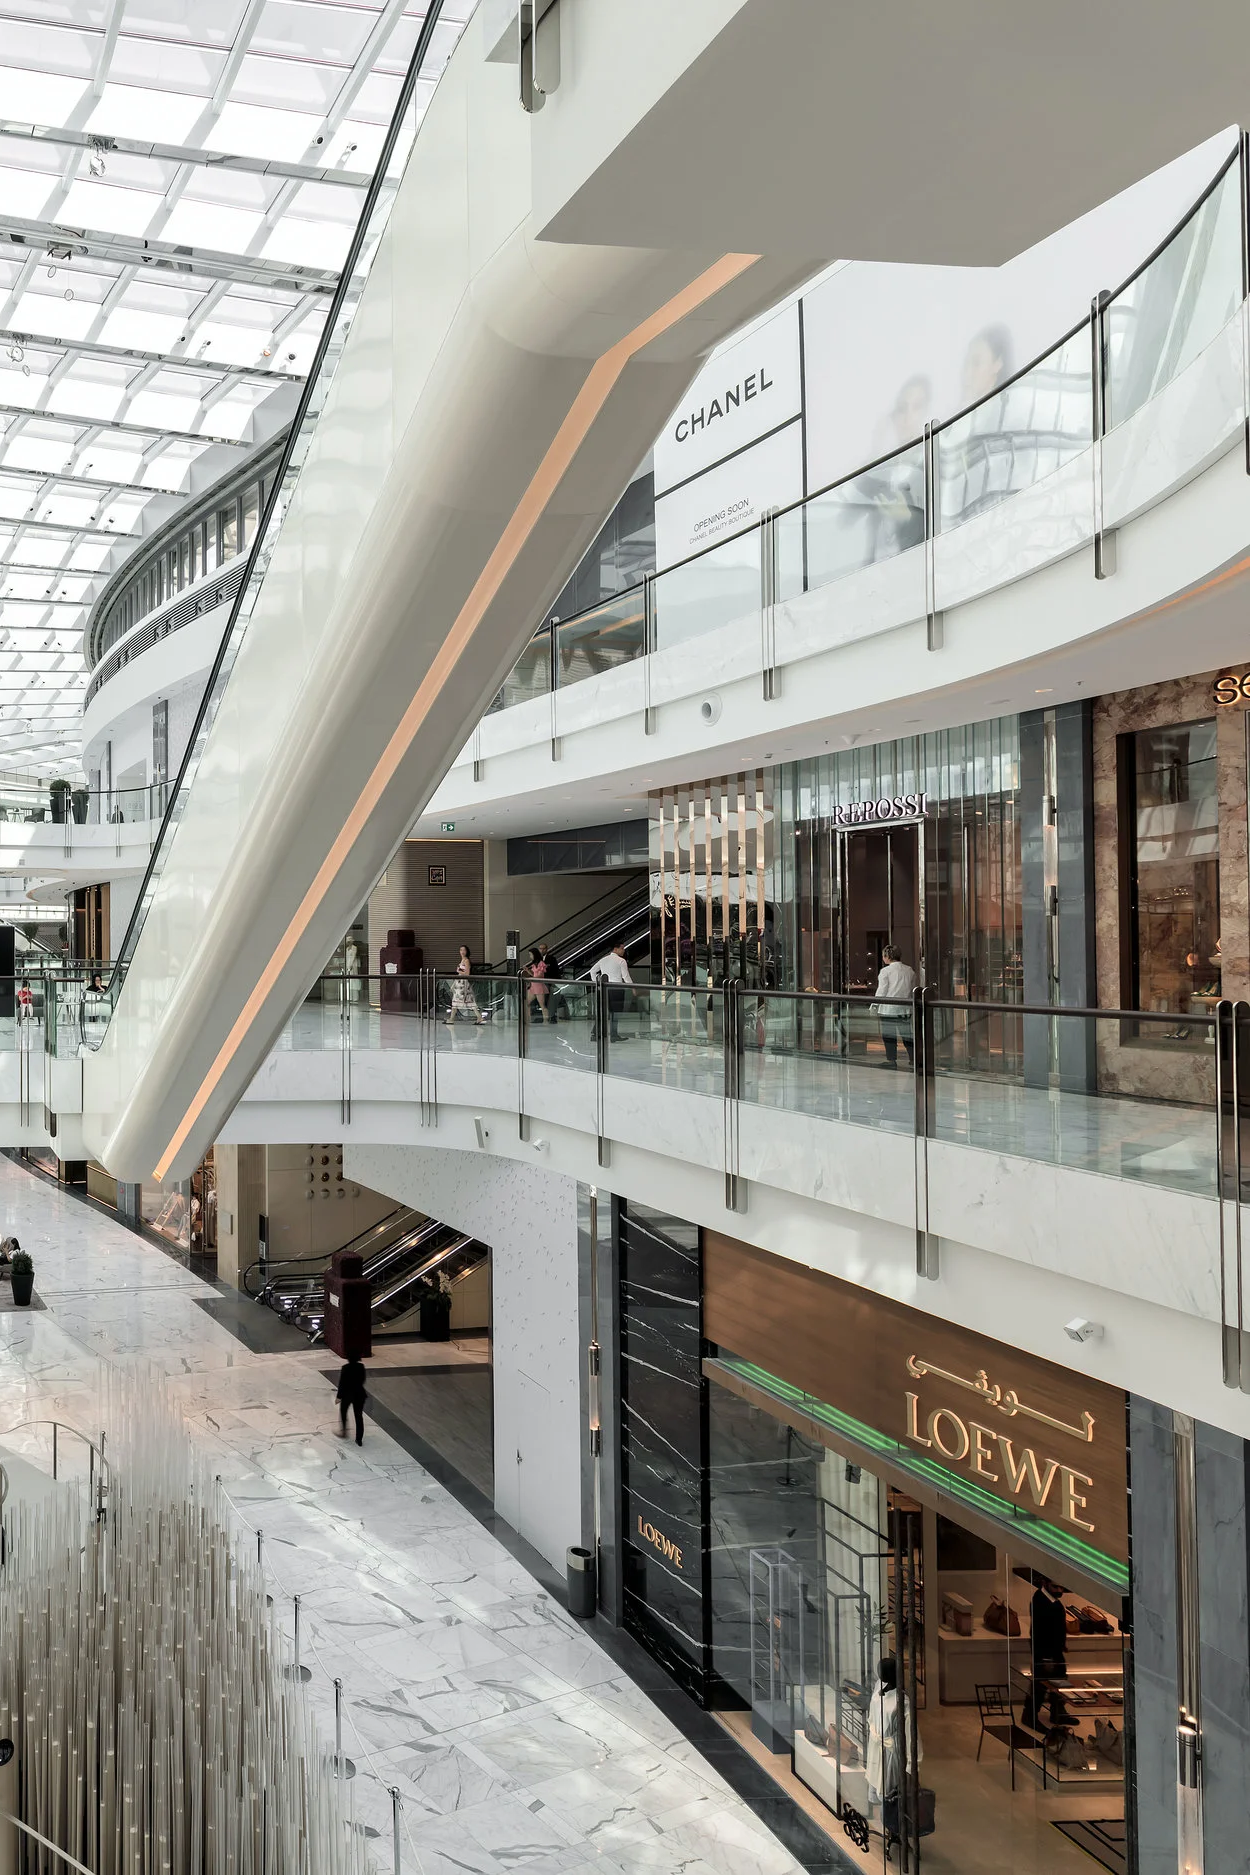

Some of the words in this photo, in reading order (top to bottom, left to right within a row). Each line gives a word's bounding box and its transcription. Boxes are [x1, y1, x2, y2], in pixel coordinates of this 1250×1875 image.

[675, 367, 773, 443] CHANEL
[689, 531, 708, 545] CHANEL
[708, 521, 728, 535] BEAUTY
[728, 507, 755, 526] BOUTIQUE
[693, 509, 726, 533] OPENING
[727, 497, 750, 516] SOON
[832, 792, 928, 825] REPOSSI
[904, 1391, 1096, 1533] LOEWE
[637, 1514, 683, 1569] LOEWE
